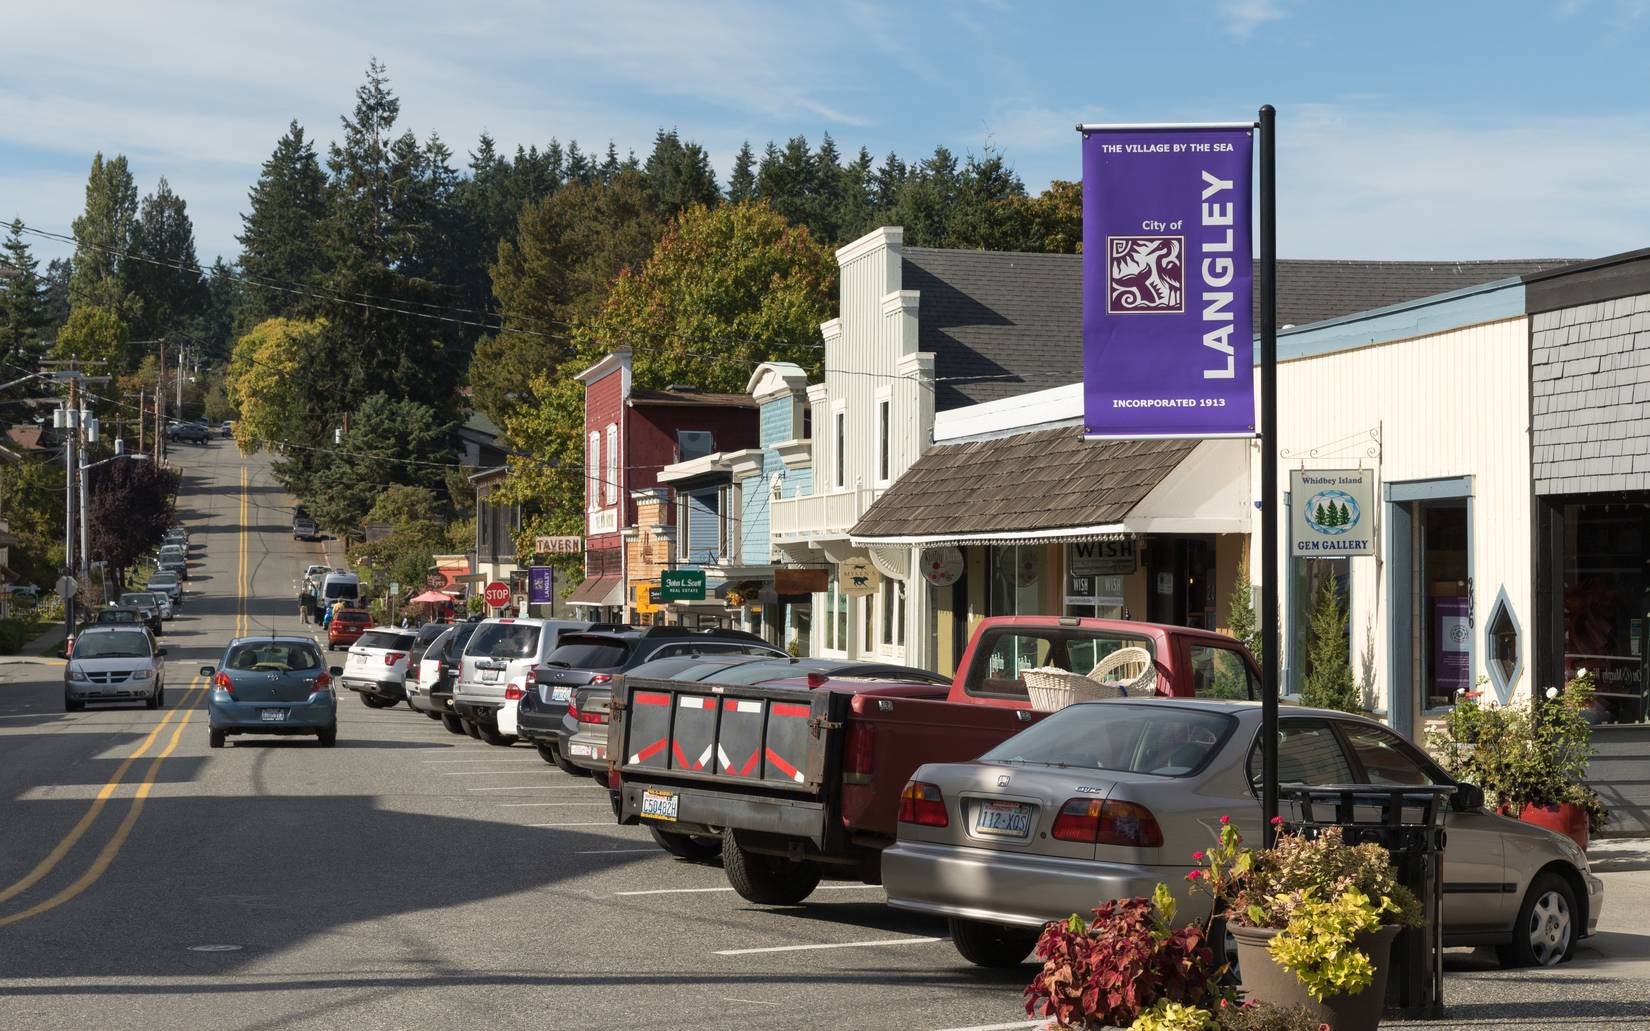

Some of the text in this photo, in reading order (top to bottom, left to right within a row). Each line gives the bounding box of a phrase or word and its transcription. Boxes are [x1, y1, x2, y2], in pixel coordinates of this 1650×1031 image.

[1101, 143, 1234, 153] THE VILLAGE BY THE SEA
[1142, 219, 1183, 232] City of
[1201, 170, 1235, 379] LANGLEY
[1112, 398, 1226, 408] INCORPORATED 1913
[1302, 476, 1362, 485] Whidbey Island
[537, 539, 579, 553] TAVERN
[1075, 541, 1132, 558] WISH
[1297, 540, 1368, 550] GEM GALLERY
[666, 578, 680, 588] John
[687, 578, 702, 587] Scott
[1073, 578, 1089, 591] WISH
[1104, 578, 1120, 592] WISH
[486, 589, 509, 600] STOP
